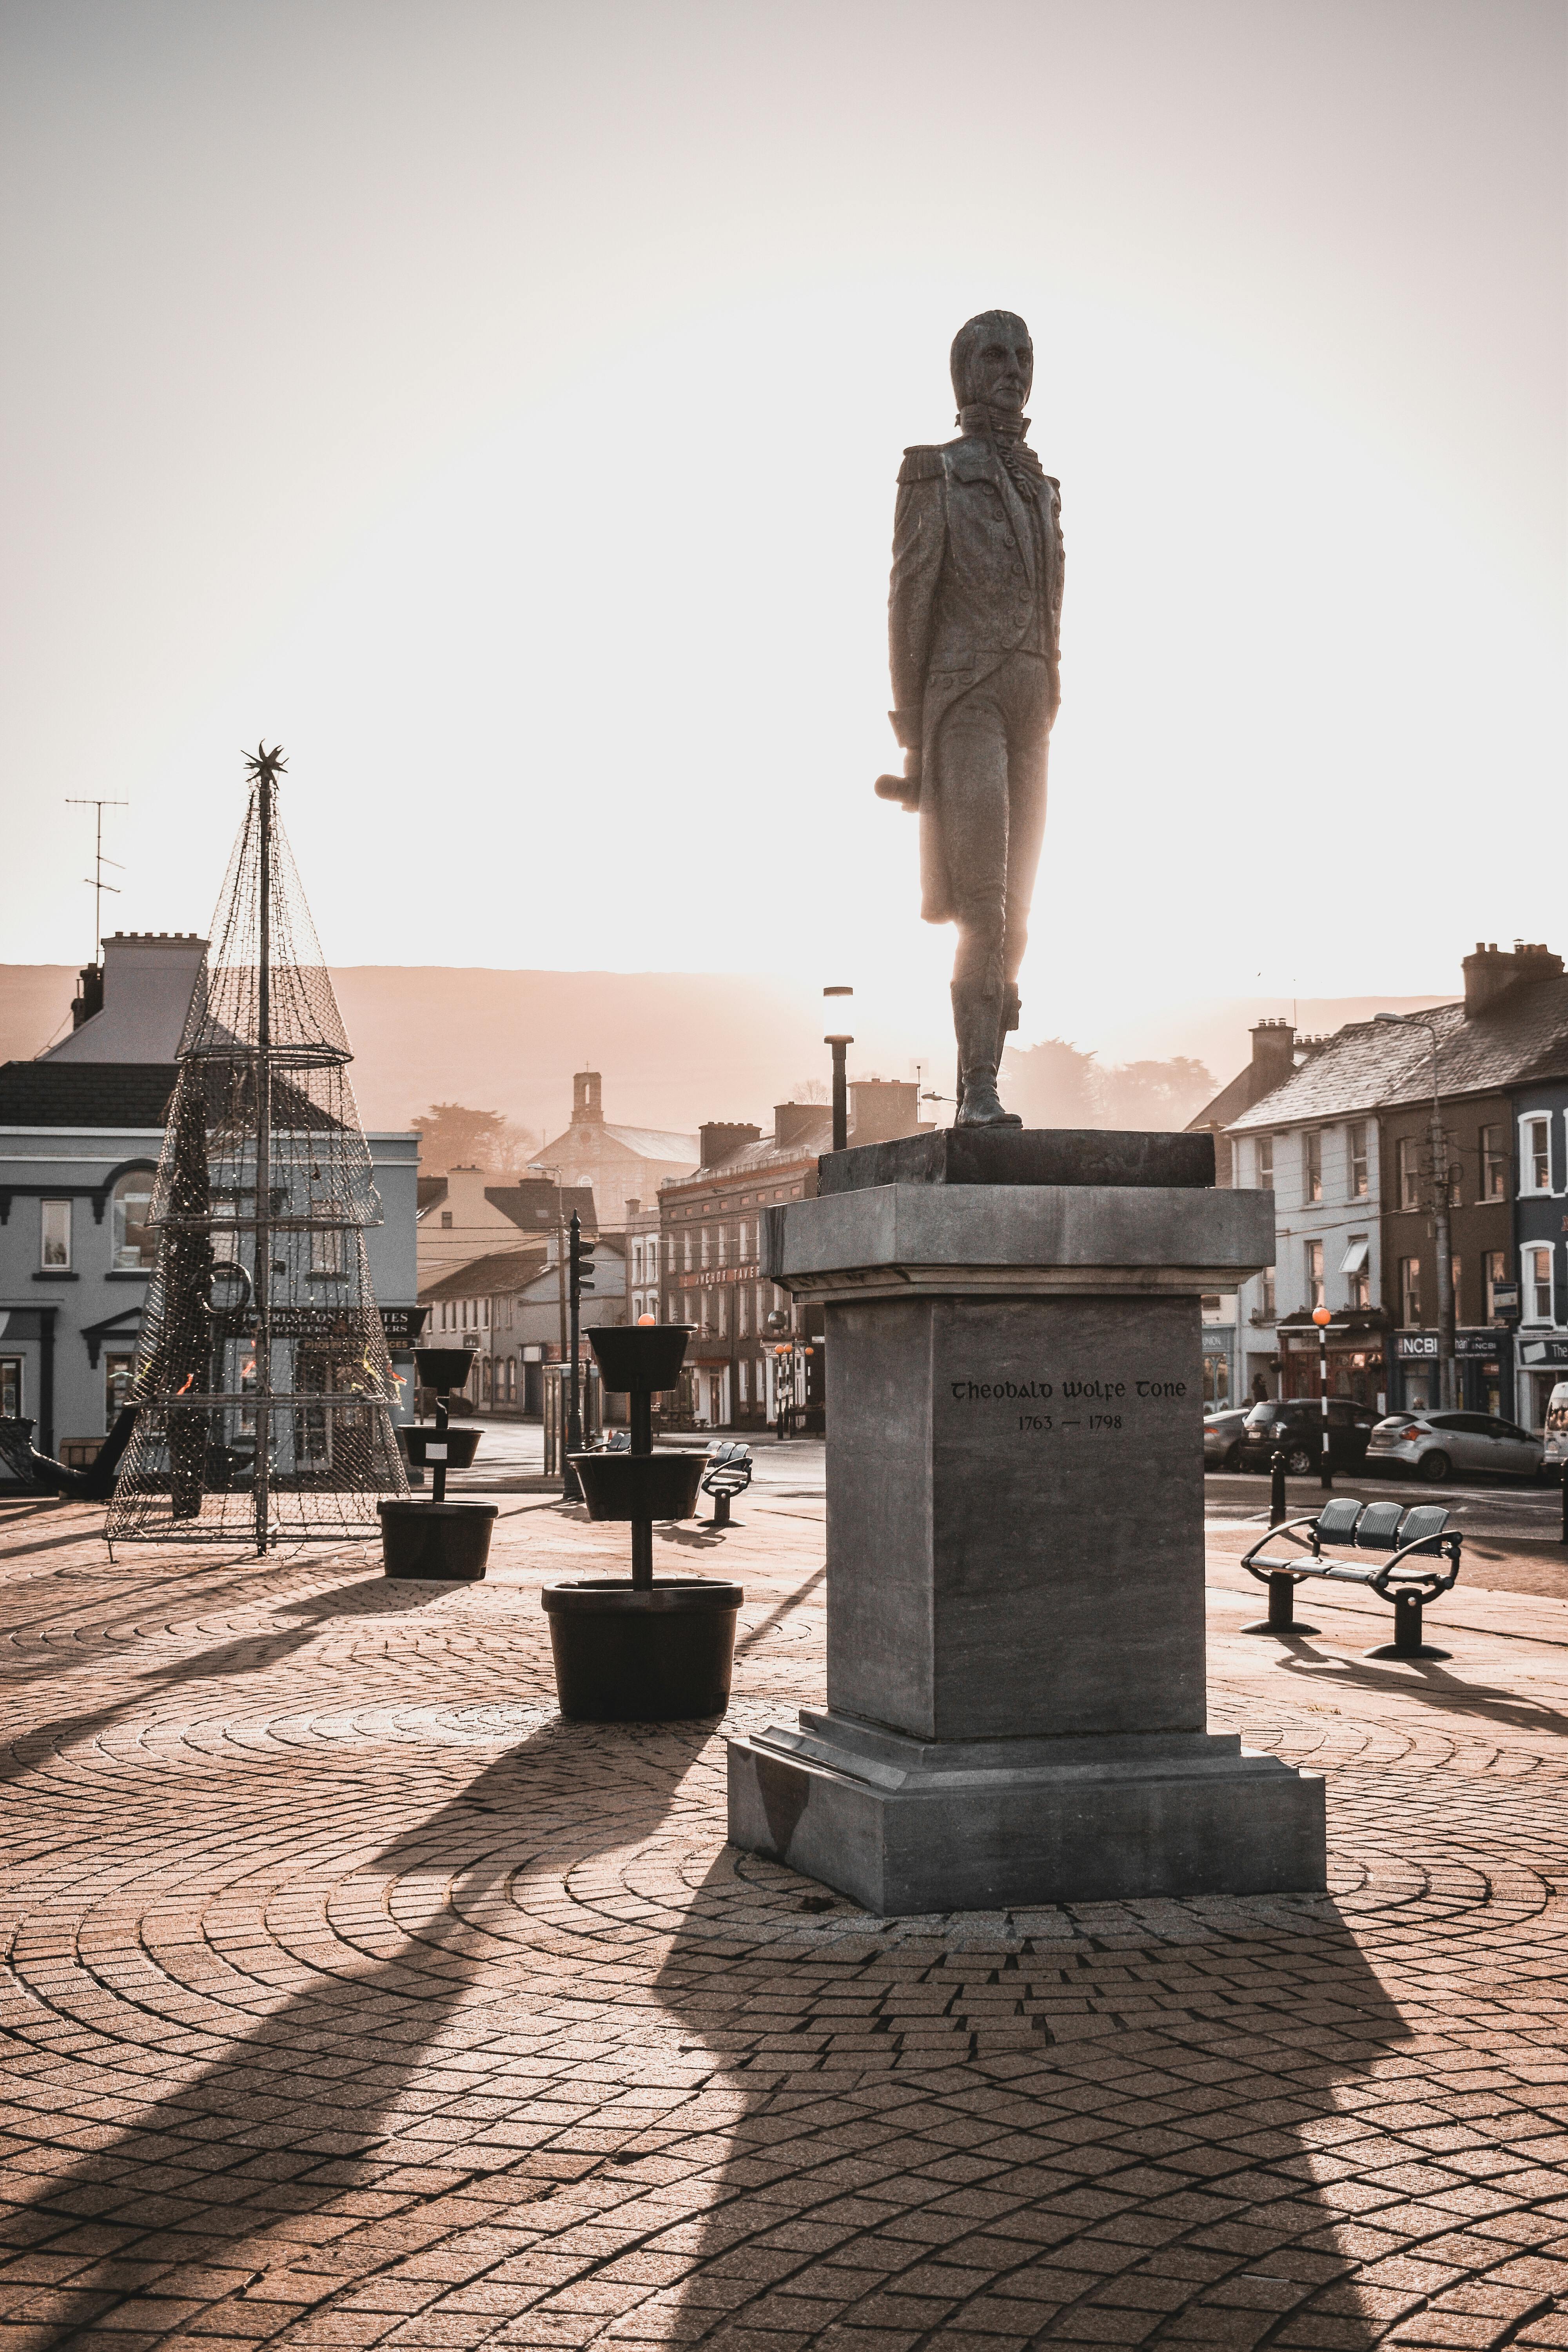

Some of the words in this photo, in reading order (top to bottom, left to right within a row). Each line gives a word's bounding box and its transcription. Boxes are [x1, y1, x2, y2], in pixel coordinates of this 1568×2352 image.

[696, 1270, 725, 1285] ANCHOR
[734, 1266, 760, 1280] TAVER
[1404, 1338, 1437, 1353] NCBI
[1551, 1344, 1568, 1357] The
[951, 1380, 1053, 1399] Theobald
[1062, 1380, 1126, 1401] Wolfe
[1136, 1381, 1187, 1397] Tone
[1019, 1415, 1053, 1430] 1763
[1089, 1415, 1122, 1430] 1798
